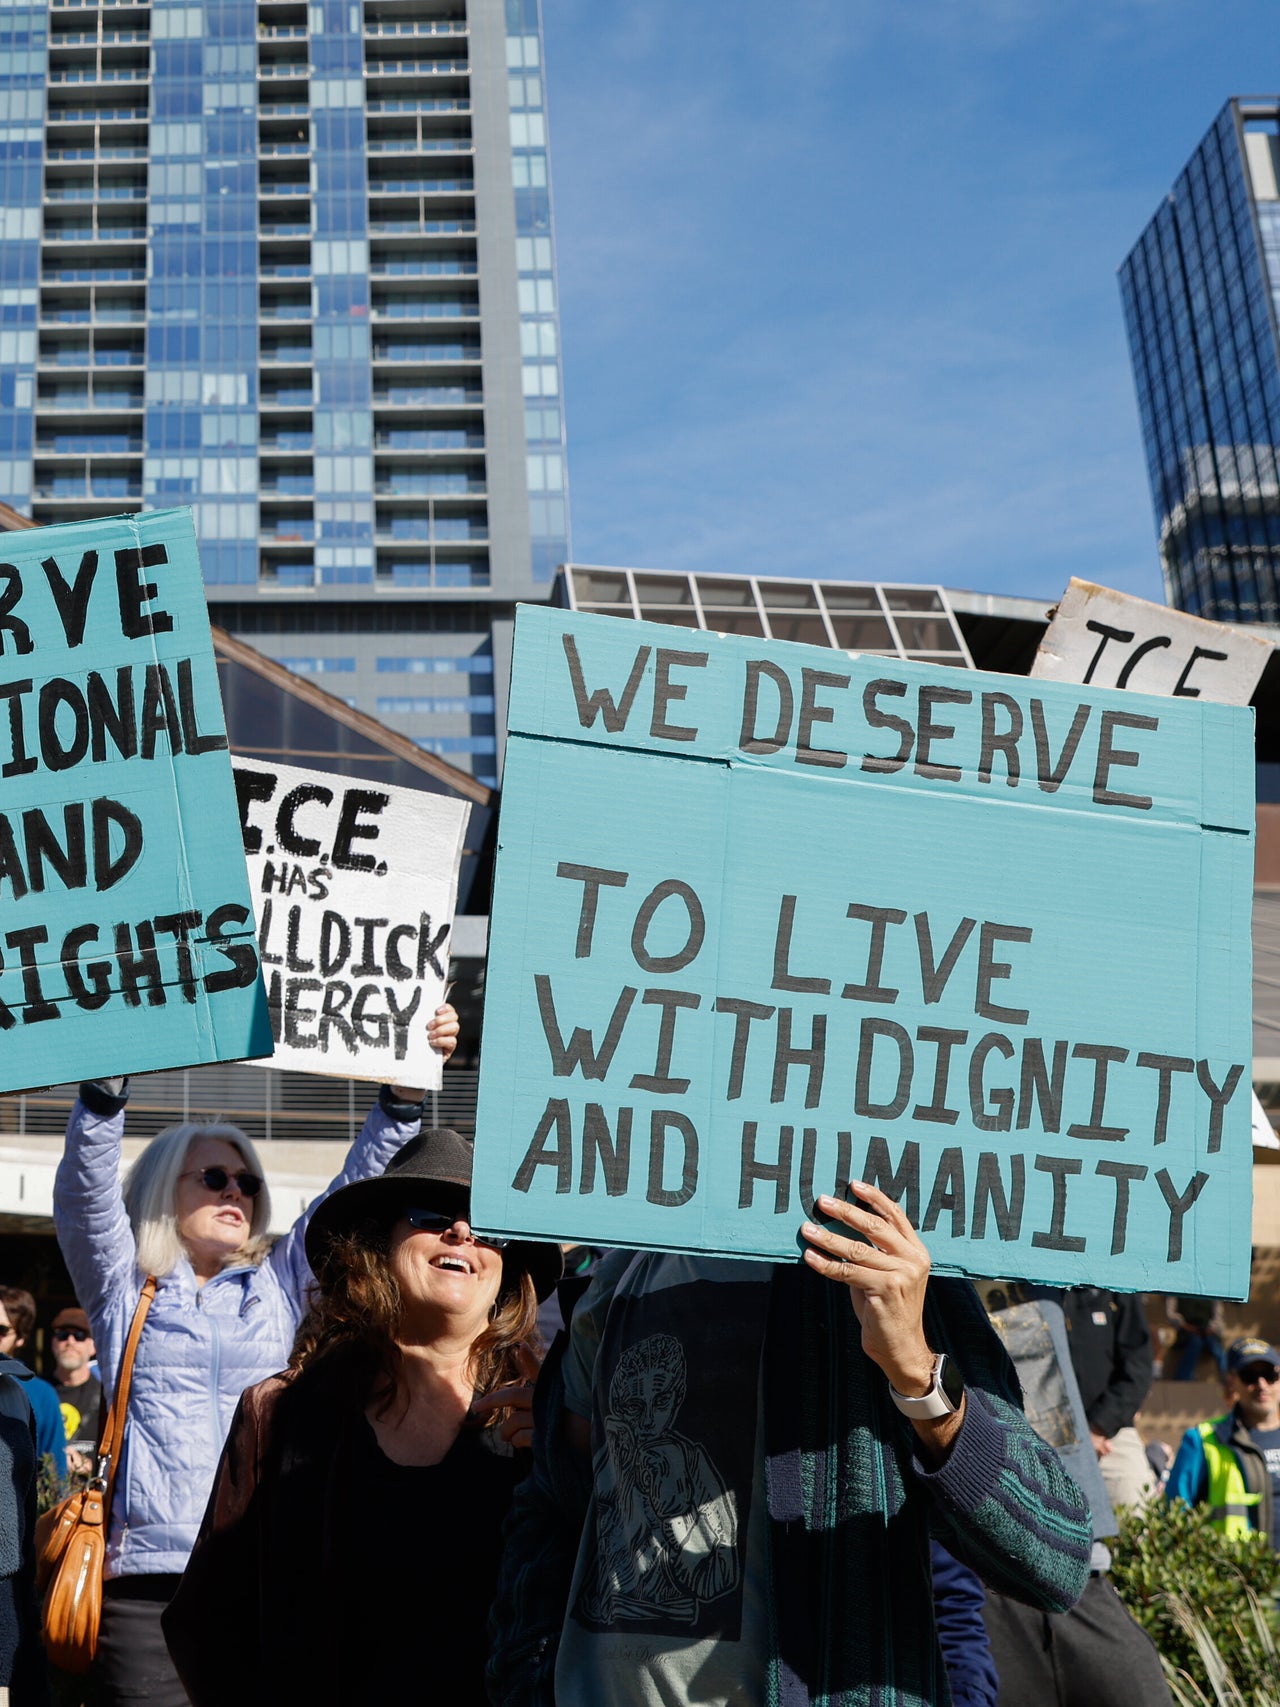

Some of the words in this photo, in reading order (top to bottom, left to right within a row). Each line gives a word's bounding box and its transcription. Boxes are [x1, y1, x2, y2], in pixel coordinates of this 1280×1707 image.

[562, 633, 709, 742] WE
[739, 659, 1160, 810] DESERVE
[261, 860, 333, 901] HAS
[320, 910, 451, 982] DICK
[556, 861, 706, 973] TO
[772, 894, 1033, 1024] LIVE
[534, 973, 827, 1109] WITH
[854, 1018, 1245, 1153] DIGNITY
[511, 1097, 700, 1207] AND
[738, 1121, 1210, 1262] HUMANITY
